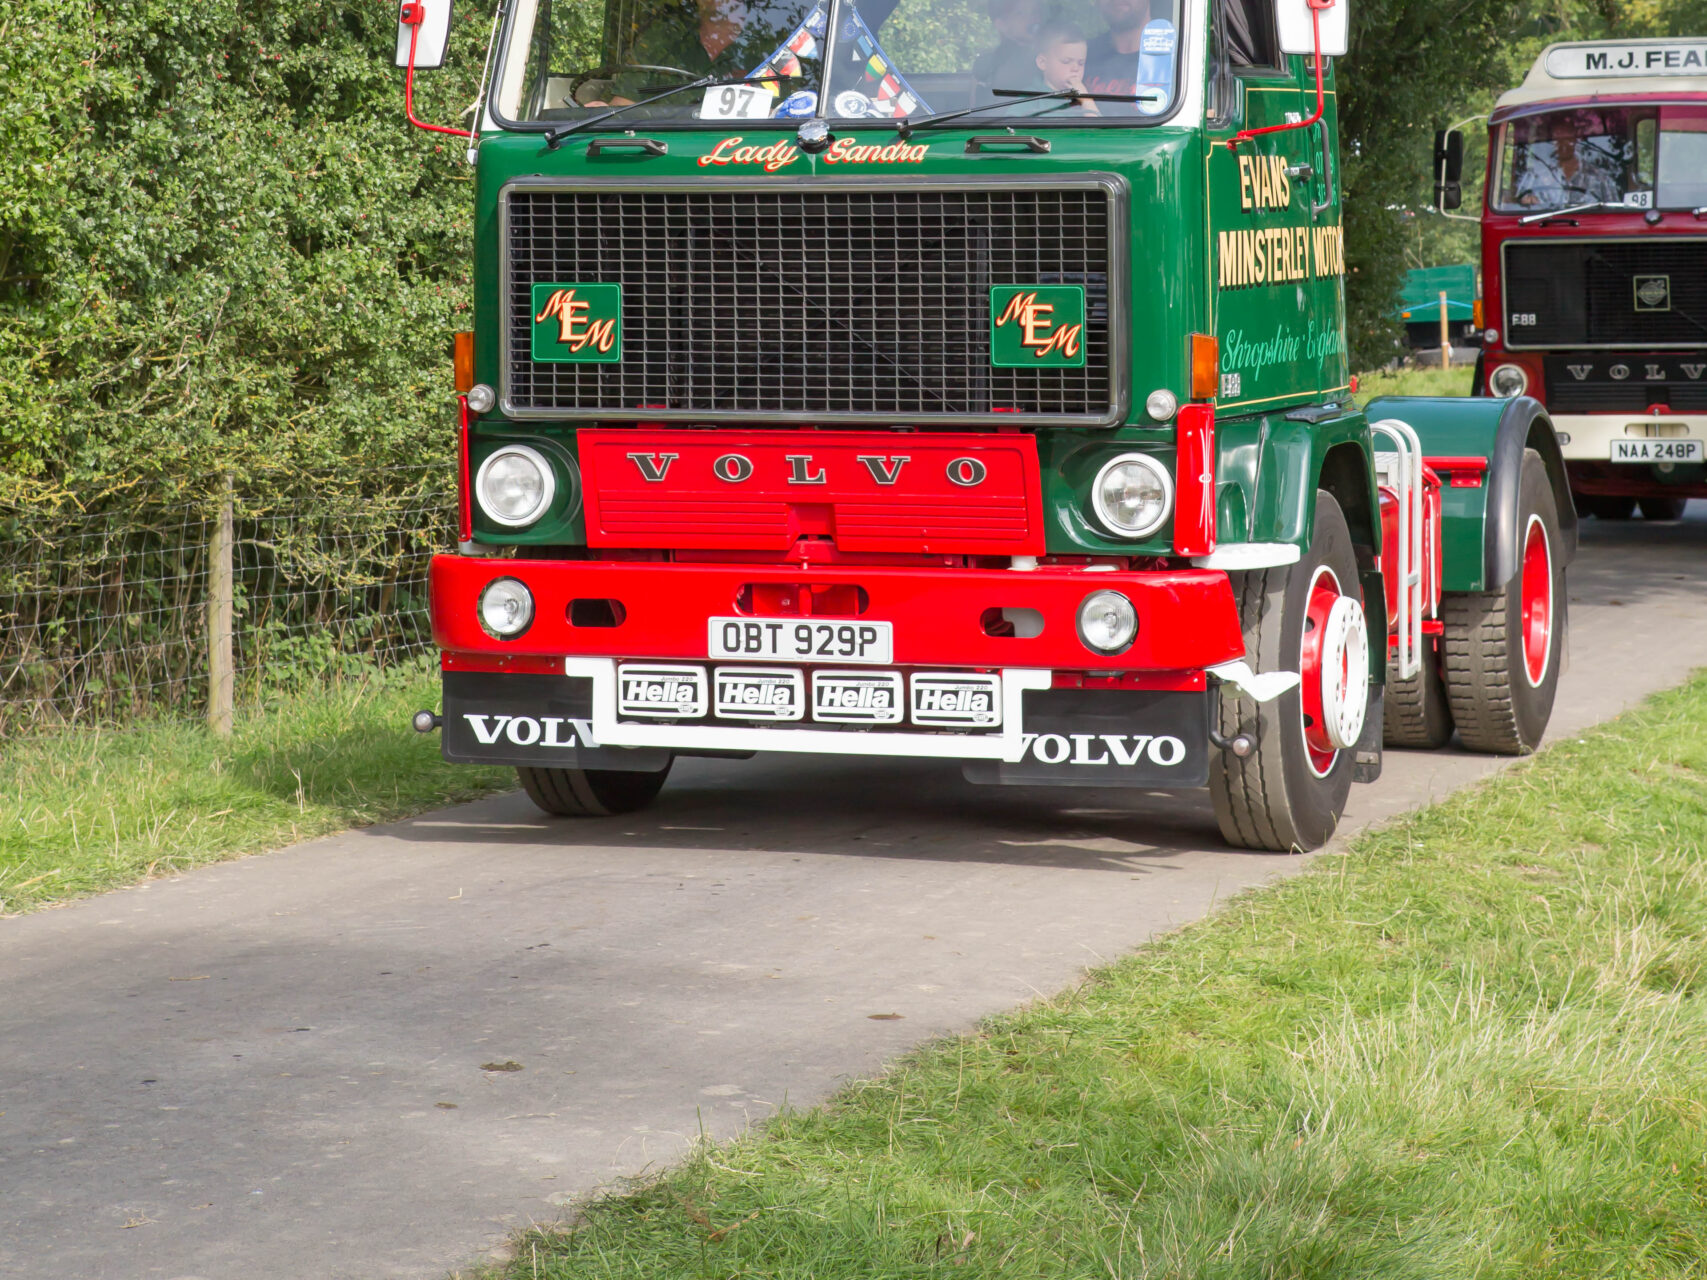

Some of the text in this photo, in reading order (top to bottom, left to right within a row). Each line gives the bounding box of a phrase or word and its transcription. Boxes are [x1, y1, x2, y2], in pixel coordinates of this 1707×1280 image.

[1586, 50, 1707, 70] M.J. FEA
[718, 87, 755, 118] 97
[698, 136, 930, 172] Lady Sandra
[1238, 155, 1290, 211] EVANS
[1631, 193, 1648, 207] 98
[1219, 227, 1310, 290] MINSTERLEY
[1511, 313, 1537, 326] F88
[1222, 323, 1300, 381] Shropshire
[1618, 443, 1696, 458] NAA 248P
[626, 451, 988, 488] VOLVO
[723, 622, 877, 657] OBT 929P
[626, 680, 694, 703] Hella
[723, 682, 791, 705] Hella
[821, 686, 890, 708] Hella
[920, 689, 989, 711] Hella
